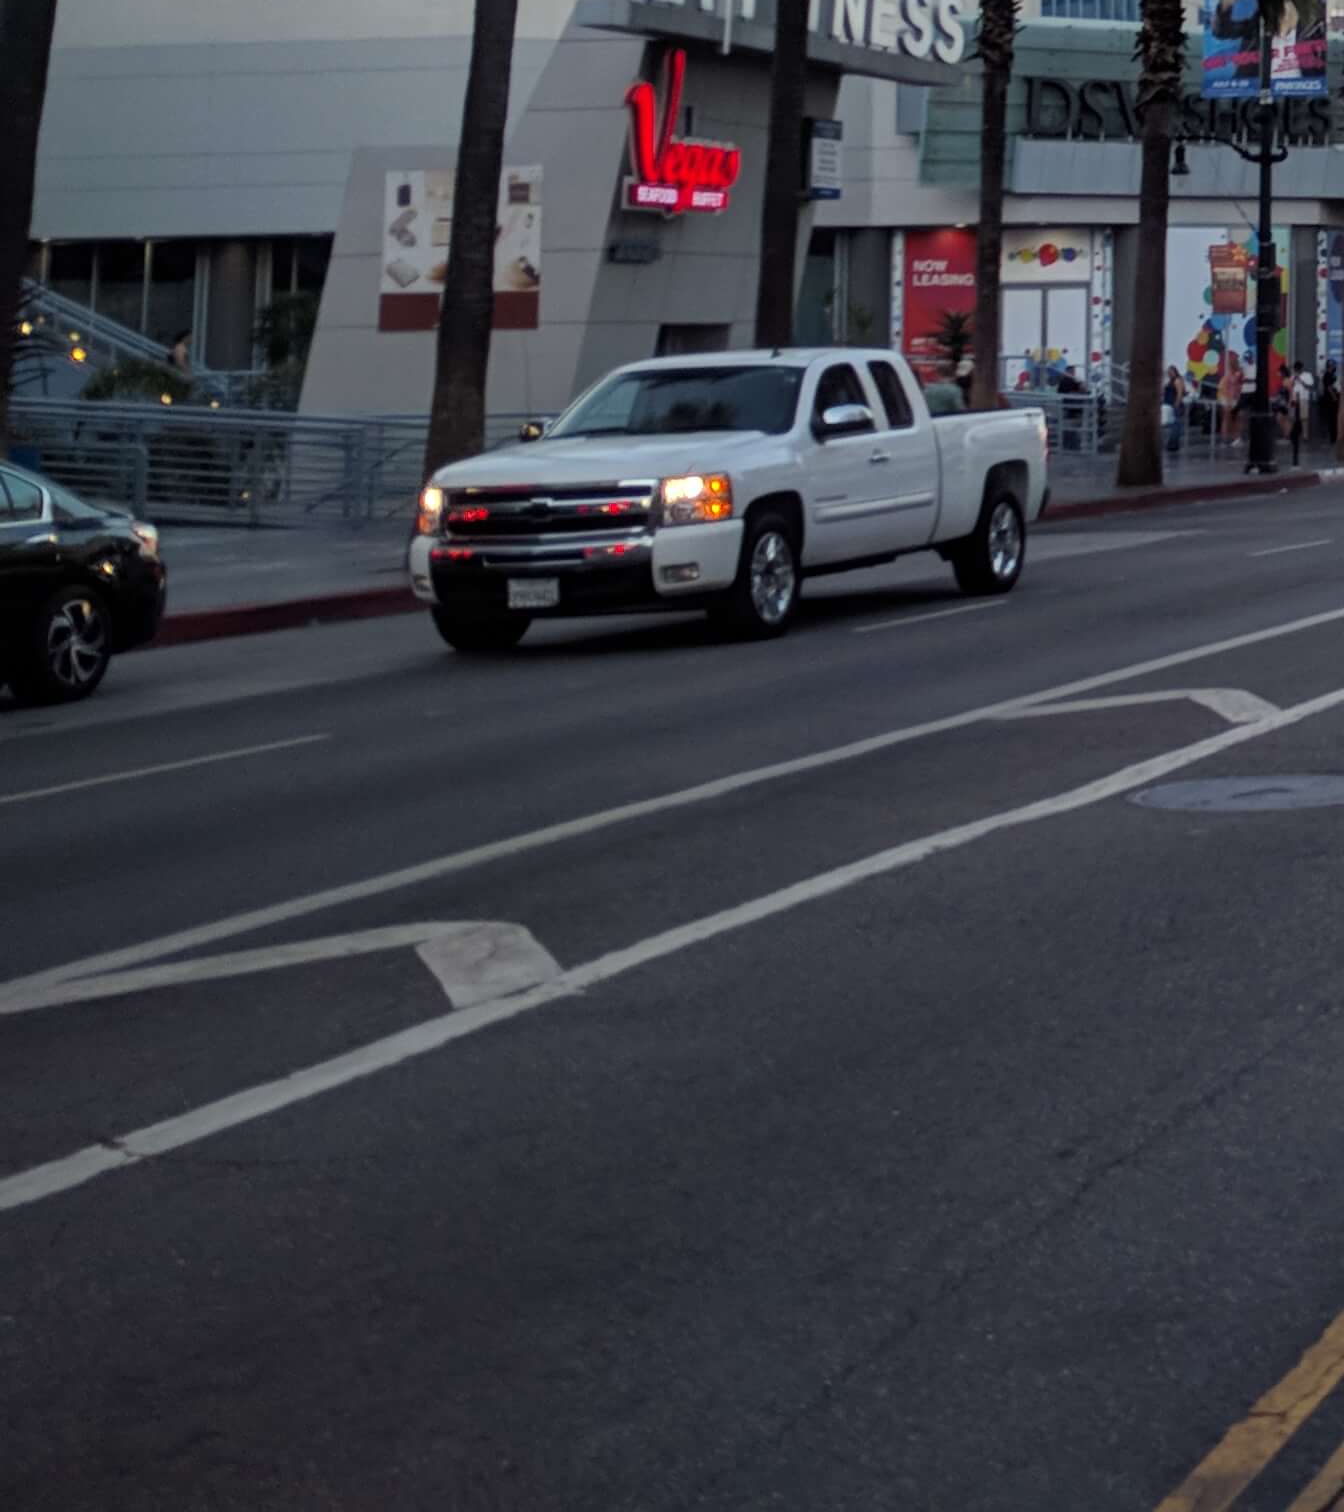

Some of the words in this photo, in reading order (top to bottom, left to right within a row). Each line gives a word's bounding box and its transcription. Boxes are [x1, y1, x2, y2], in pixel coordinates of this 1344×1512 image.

[625, 48, 741, 216] Vegas
[912, 259, 948, 272] NOW
[912, 273, 976, 286] LEASING
